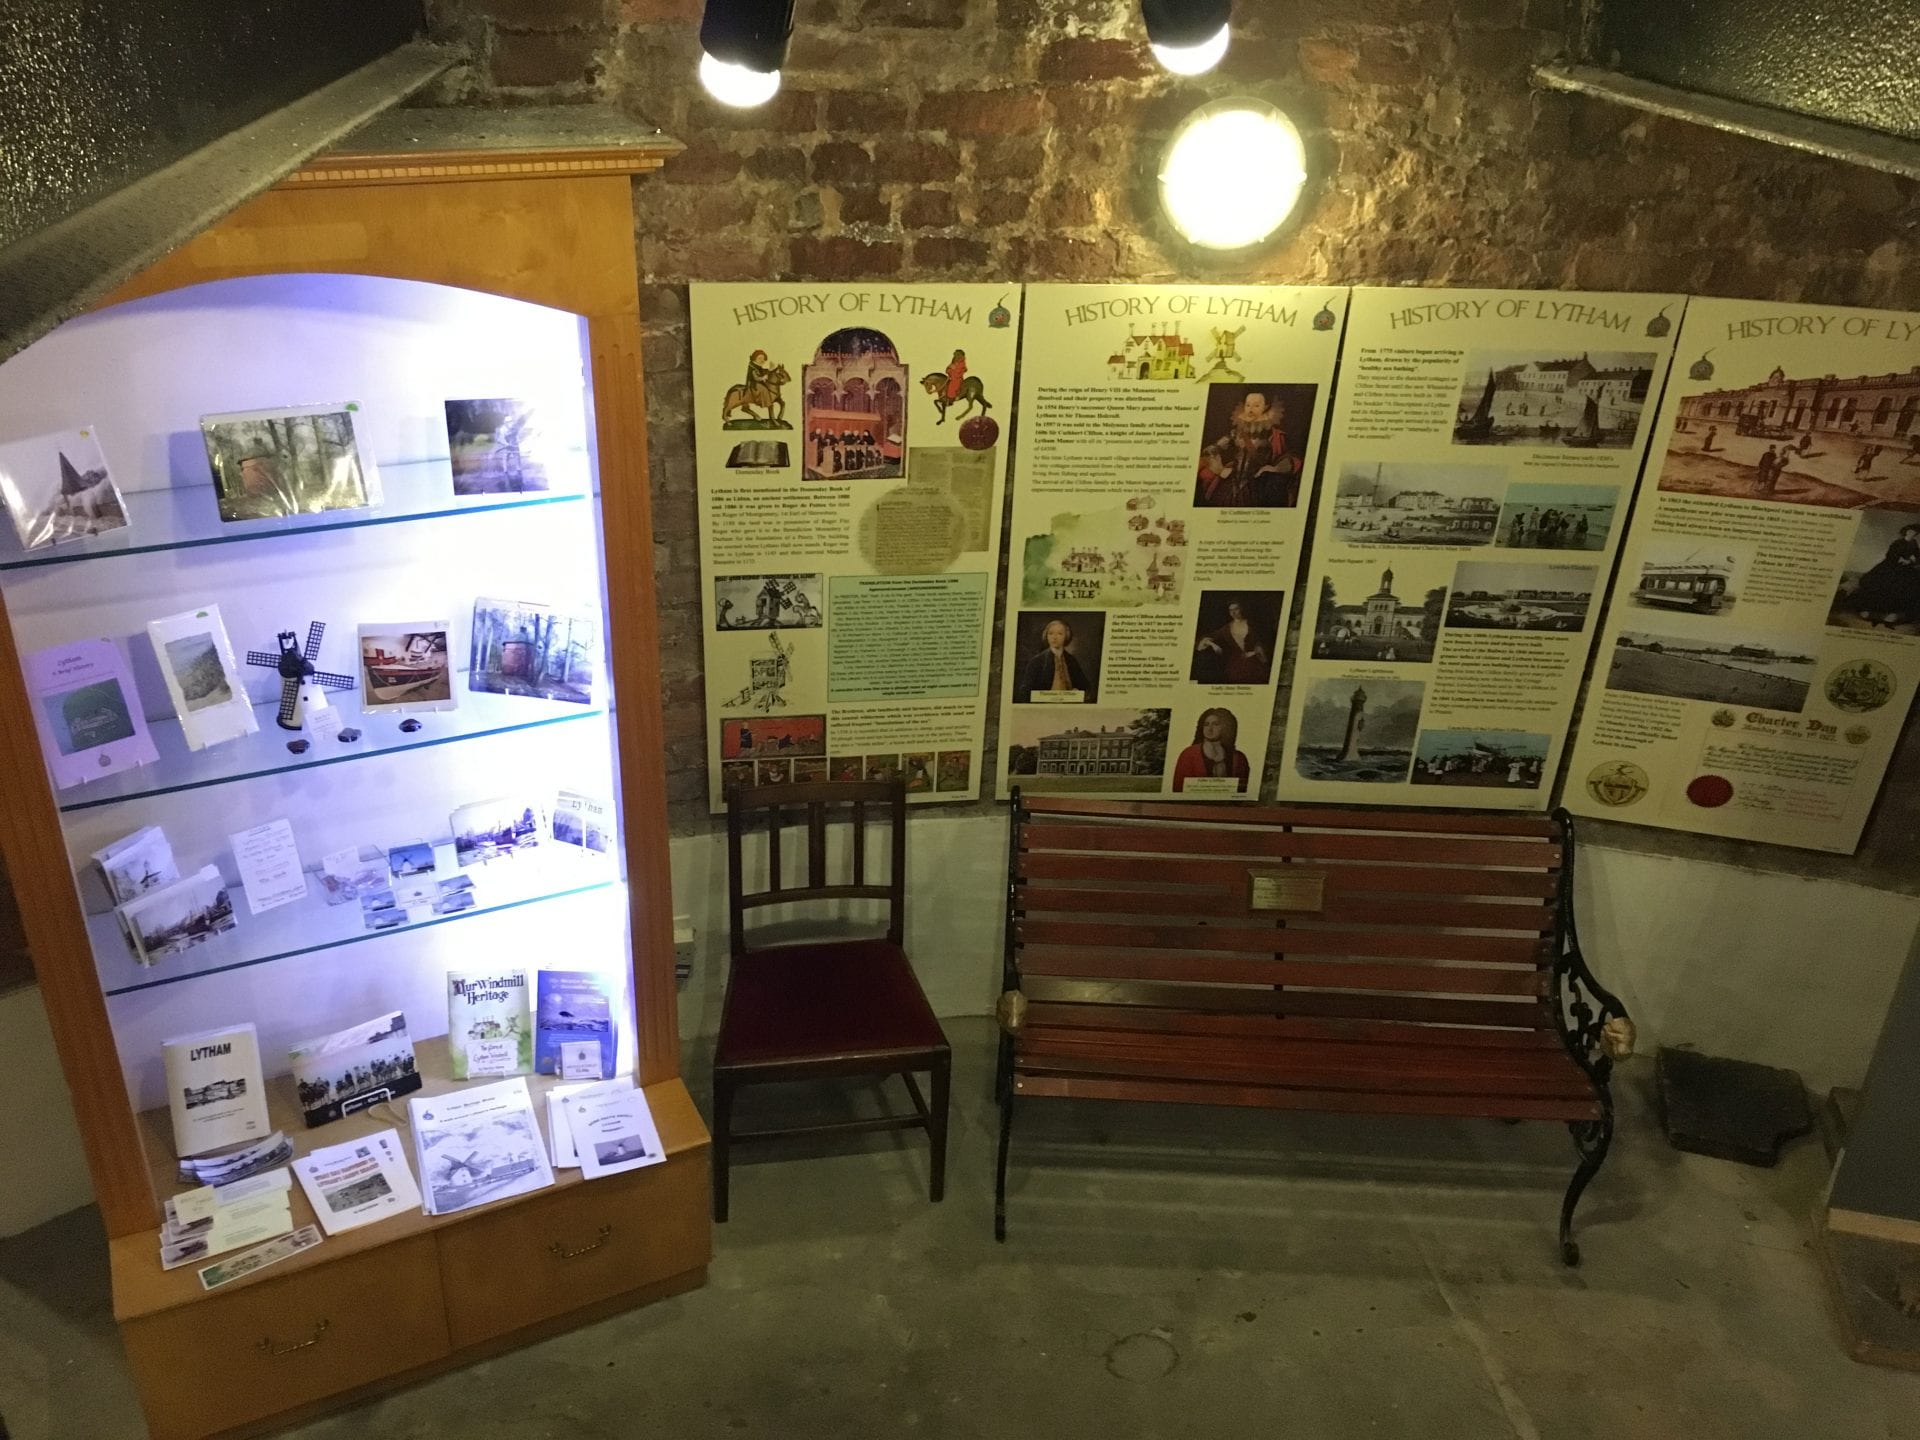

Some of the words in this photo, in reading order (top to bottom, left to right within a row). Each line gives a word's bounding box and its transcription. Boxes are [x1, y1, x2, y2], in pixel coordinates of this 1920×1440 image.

[733, 293, 832, 326] HISTORY
[839, 292, 870, 313] OF
[879, 293, 973, 325] LYTHAM
[1064, 295, 1161, 327] HISTORY
[1168, 294, 1198, 315] OF
[1206, 296, 1299, 328] LYTHAM
[1390, 300, 1490, 330] HISTORY
[1496, 299, 1530, 318] OF
[1536, 300, 1632, 333] LYTHAM
[1727, 315, 1837, 341] HISTORY
[1843, 315, 1880, 337] OF
[1044, 577, 1101, 589] LETHAM
[1746, 712, 1800, 728] Charter
[1806, 720, 1838, 735] Day
[477, 974, 524, 991] Windmill
[464, 990, 510, 1006] Heritage
[190, 1042, 232, 1062] LYTHAM
